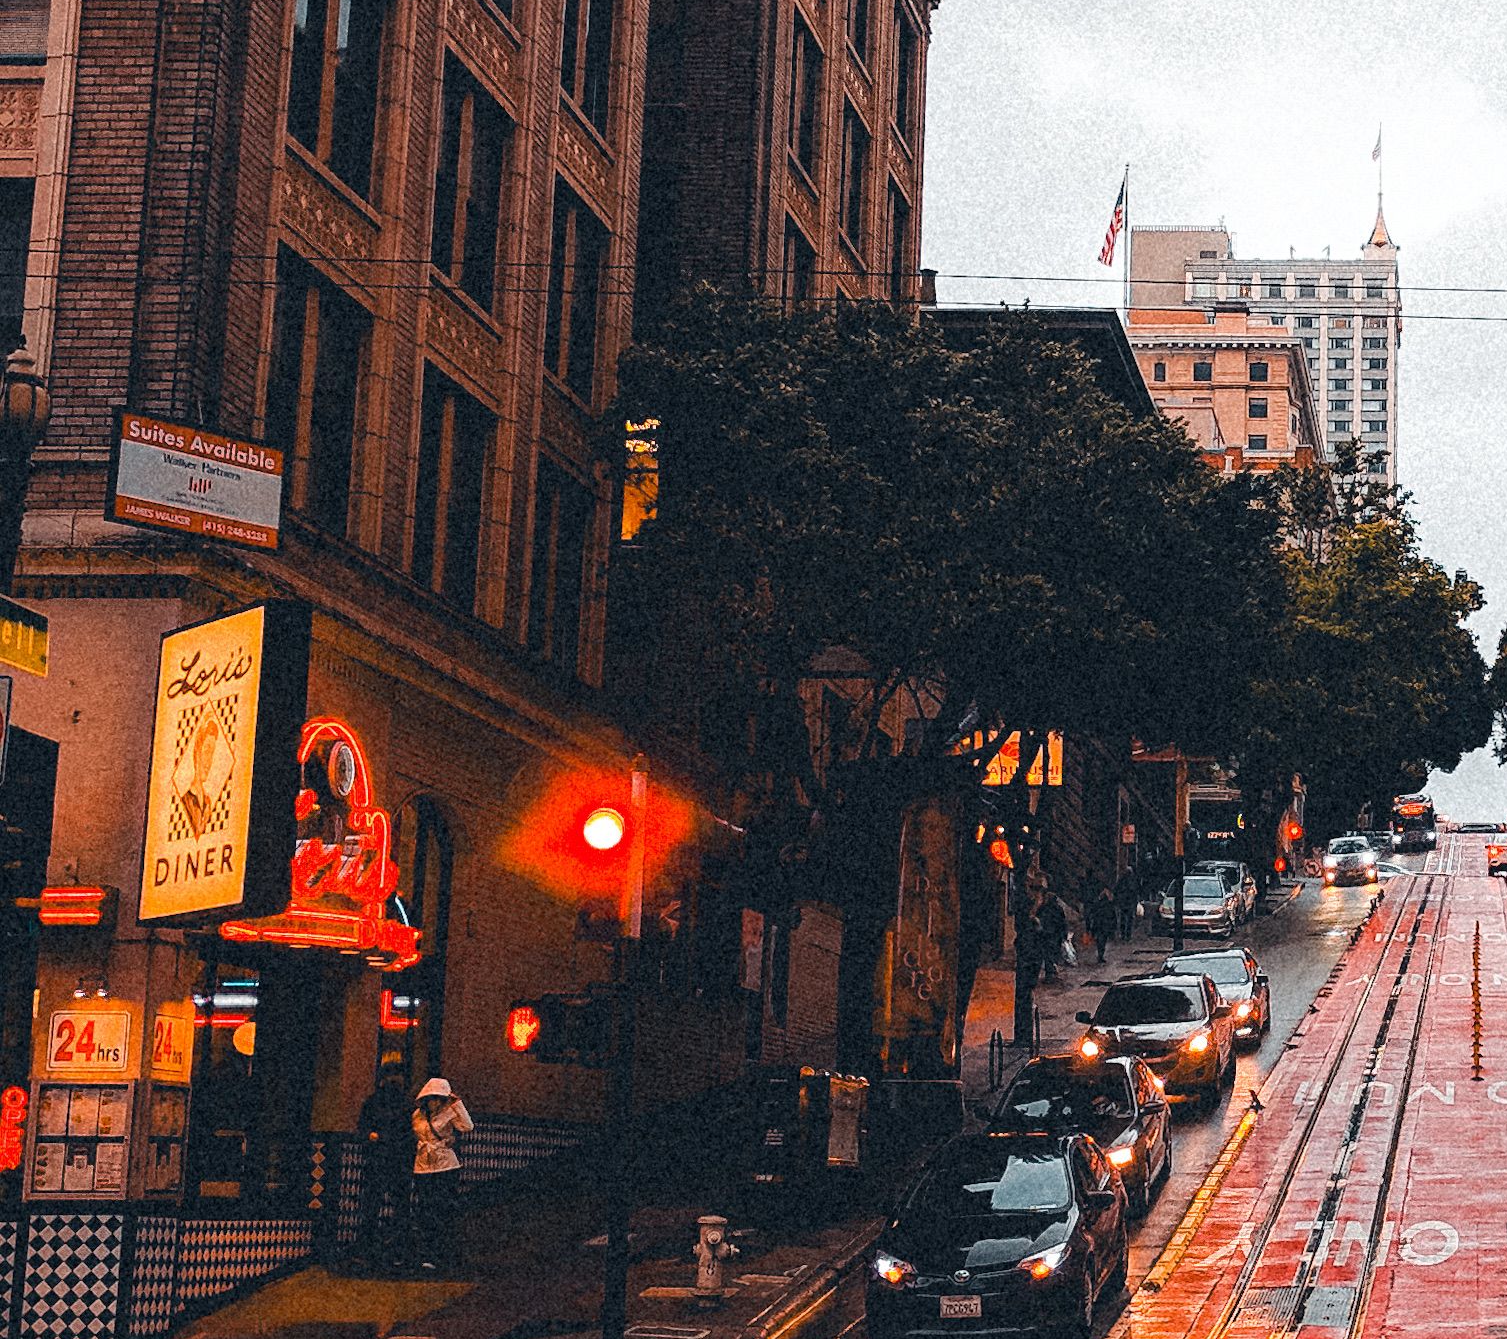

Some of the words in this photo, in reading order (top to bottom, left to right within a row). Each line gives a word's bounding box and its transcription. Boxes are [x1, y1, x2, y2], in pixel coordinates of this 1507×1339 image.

[129, 420, 185, 449] Suites
[190, 436, 275, 470] Available
[162, 452, 197, 471] Walker
[201, 461, 241, 481] Partners
[155, 510, 192, 526] WALKER
[166, 646, 253, 700] Lori's
[154, 843, 234, 888] DINER
[1196, 1220, 1460, 1268] ONLY
